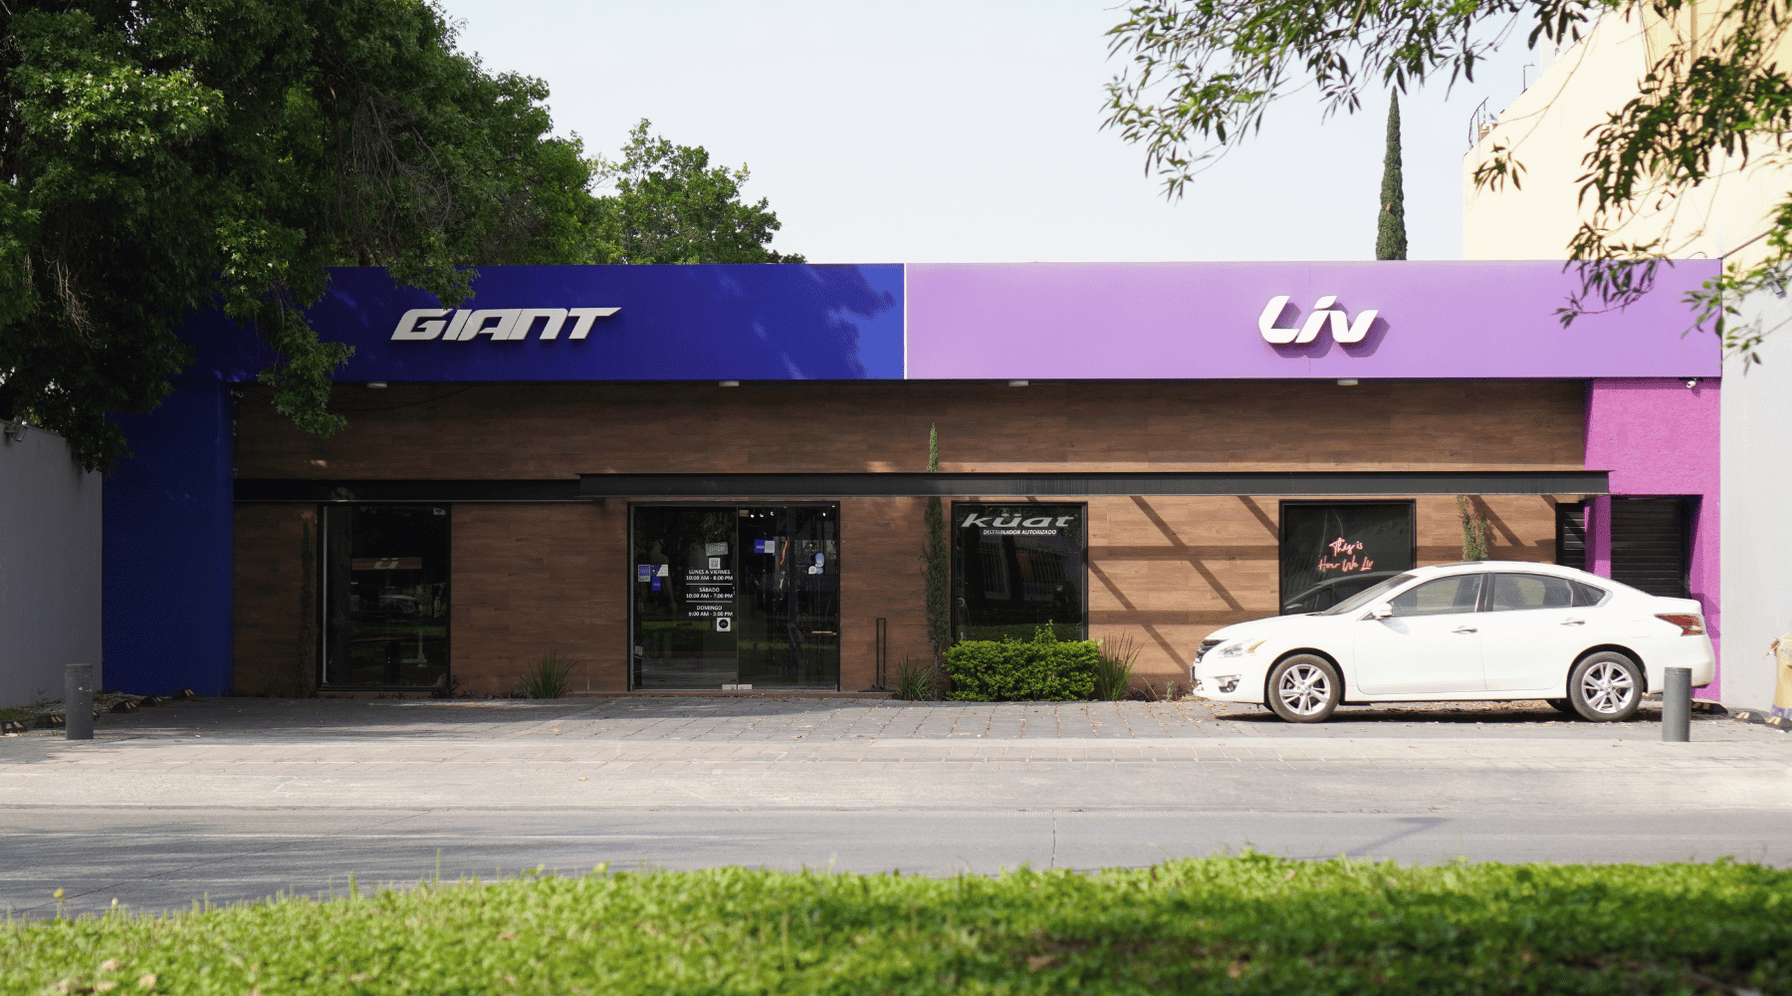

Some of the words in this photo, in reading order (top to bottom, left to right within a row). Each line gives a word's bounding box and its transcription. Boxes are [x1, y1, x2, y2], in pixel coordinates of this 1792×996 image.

[390, 307, 622, 341] GIANT
[1258, 295, 1379, 343] Liv
[961, 513, 1074, 528] küat
